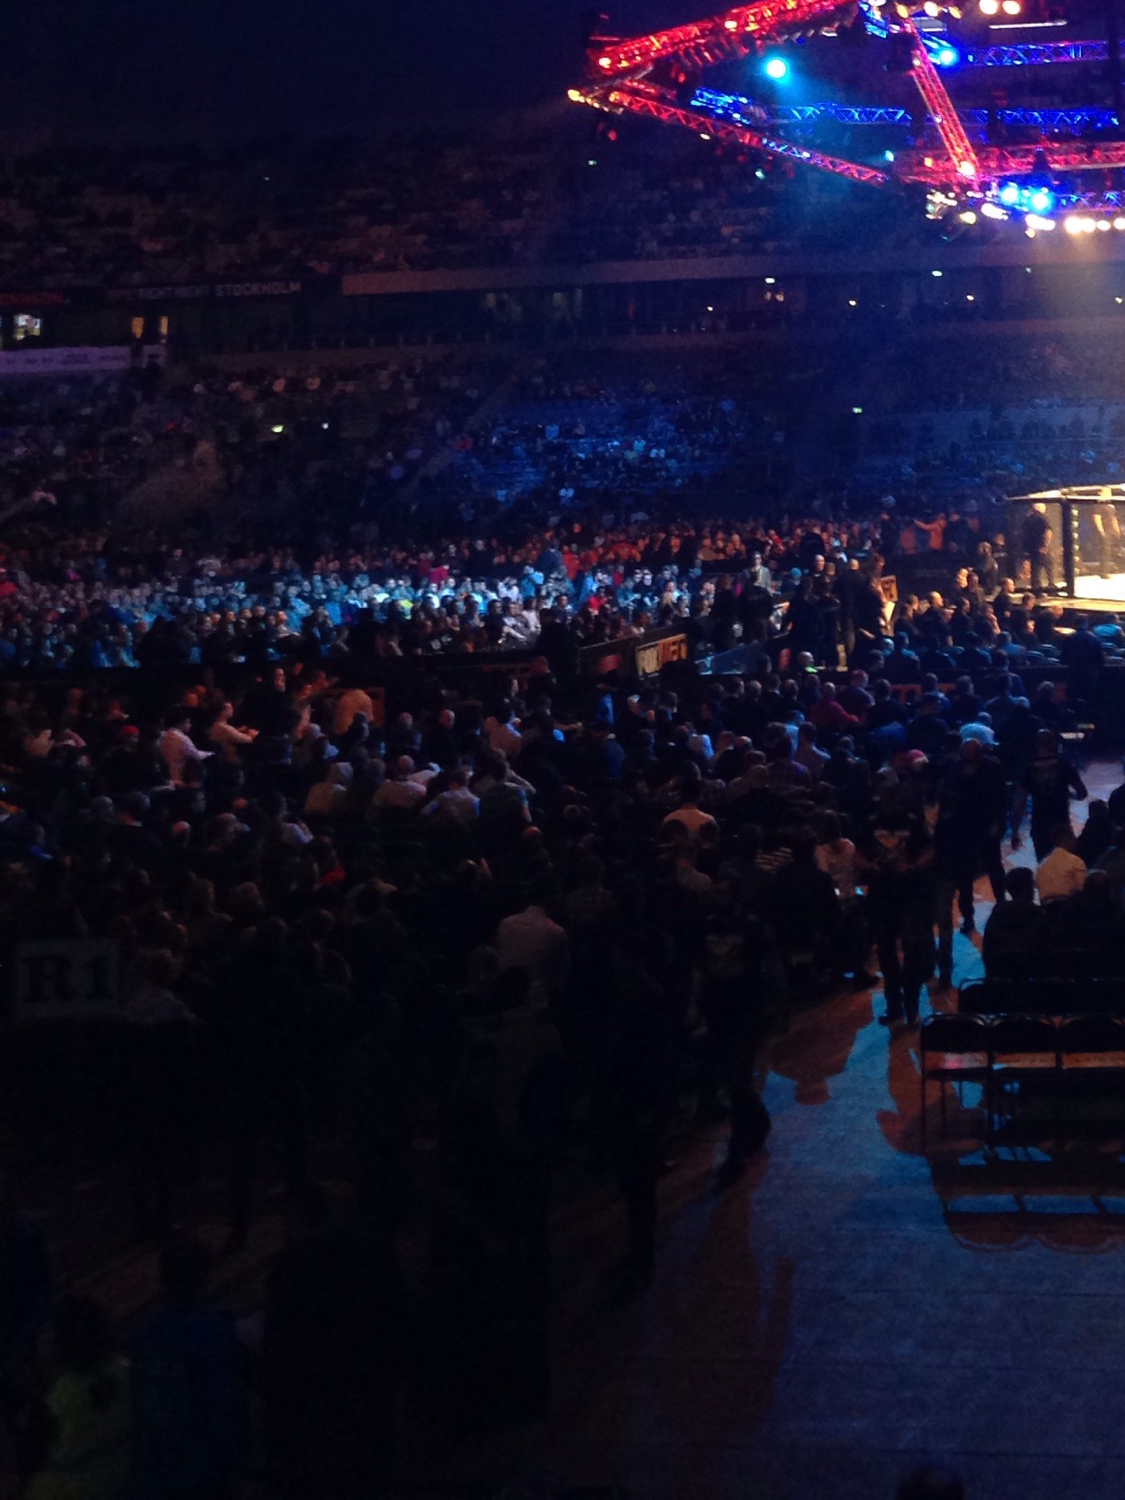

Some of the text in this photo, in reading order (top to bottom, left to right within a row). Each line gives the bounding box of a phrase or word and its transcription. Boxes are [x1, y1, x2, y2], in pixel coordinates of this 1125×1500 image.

[138, 287, 173, 301] FIGHT
[215, 282, 302, 297] STOCKHOLM
[22, 956, 113, 1002] R1
